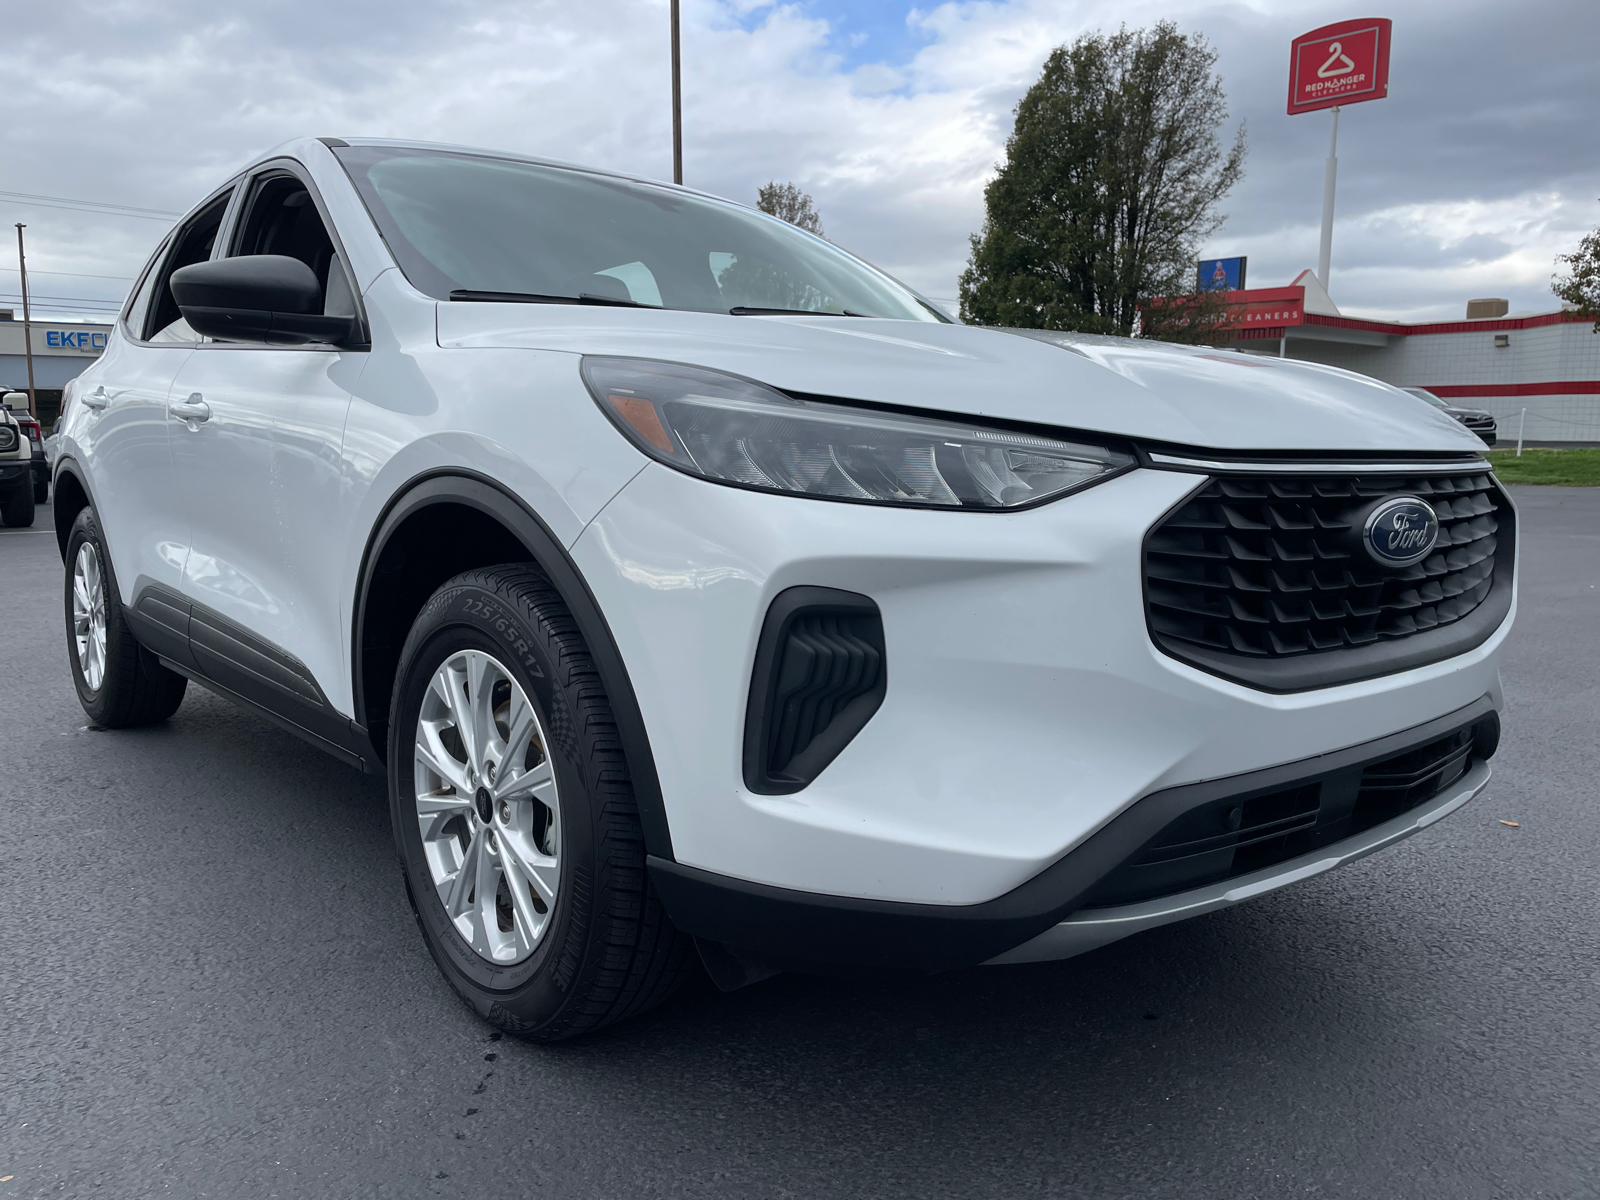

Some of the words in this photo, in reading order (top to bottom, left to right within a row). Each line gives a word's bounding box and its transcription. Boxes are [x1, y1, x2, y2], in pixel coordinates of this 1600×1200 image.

[1305, 83, 1323, 92] RED
[1312, 84, 1356, 97] CLEANERS
[1388, 512, 1428, 550] Ford
[462, 598, 545, 679] 225/65R17
